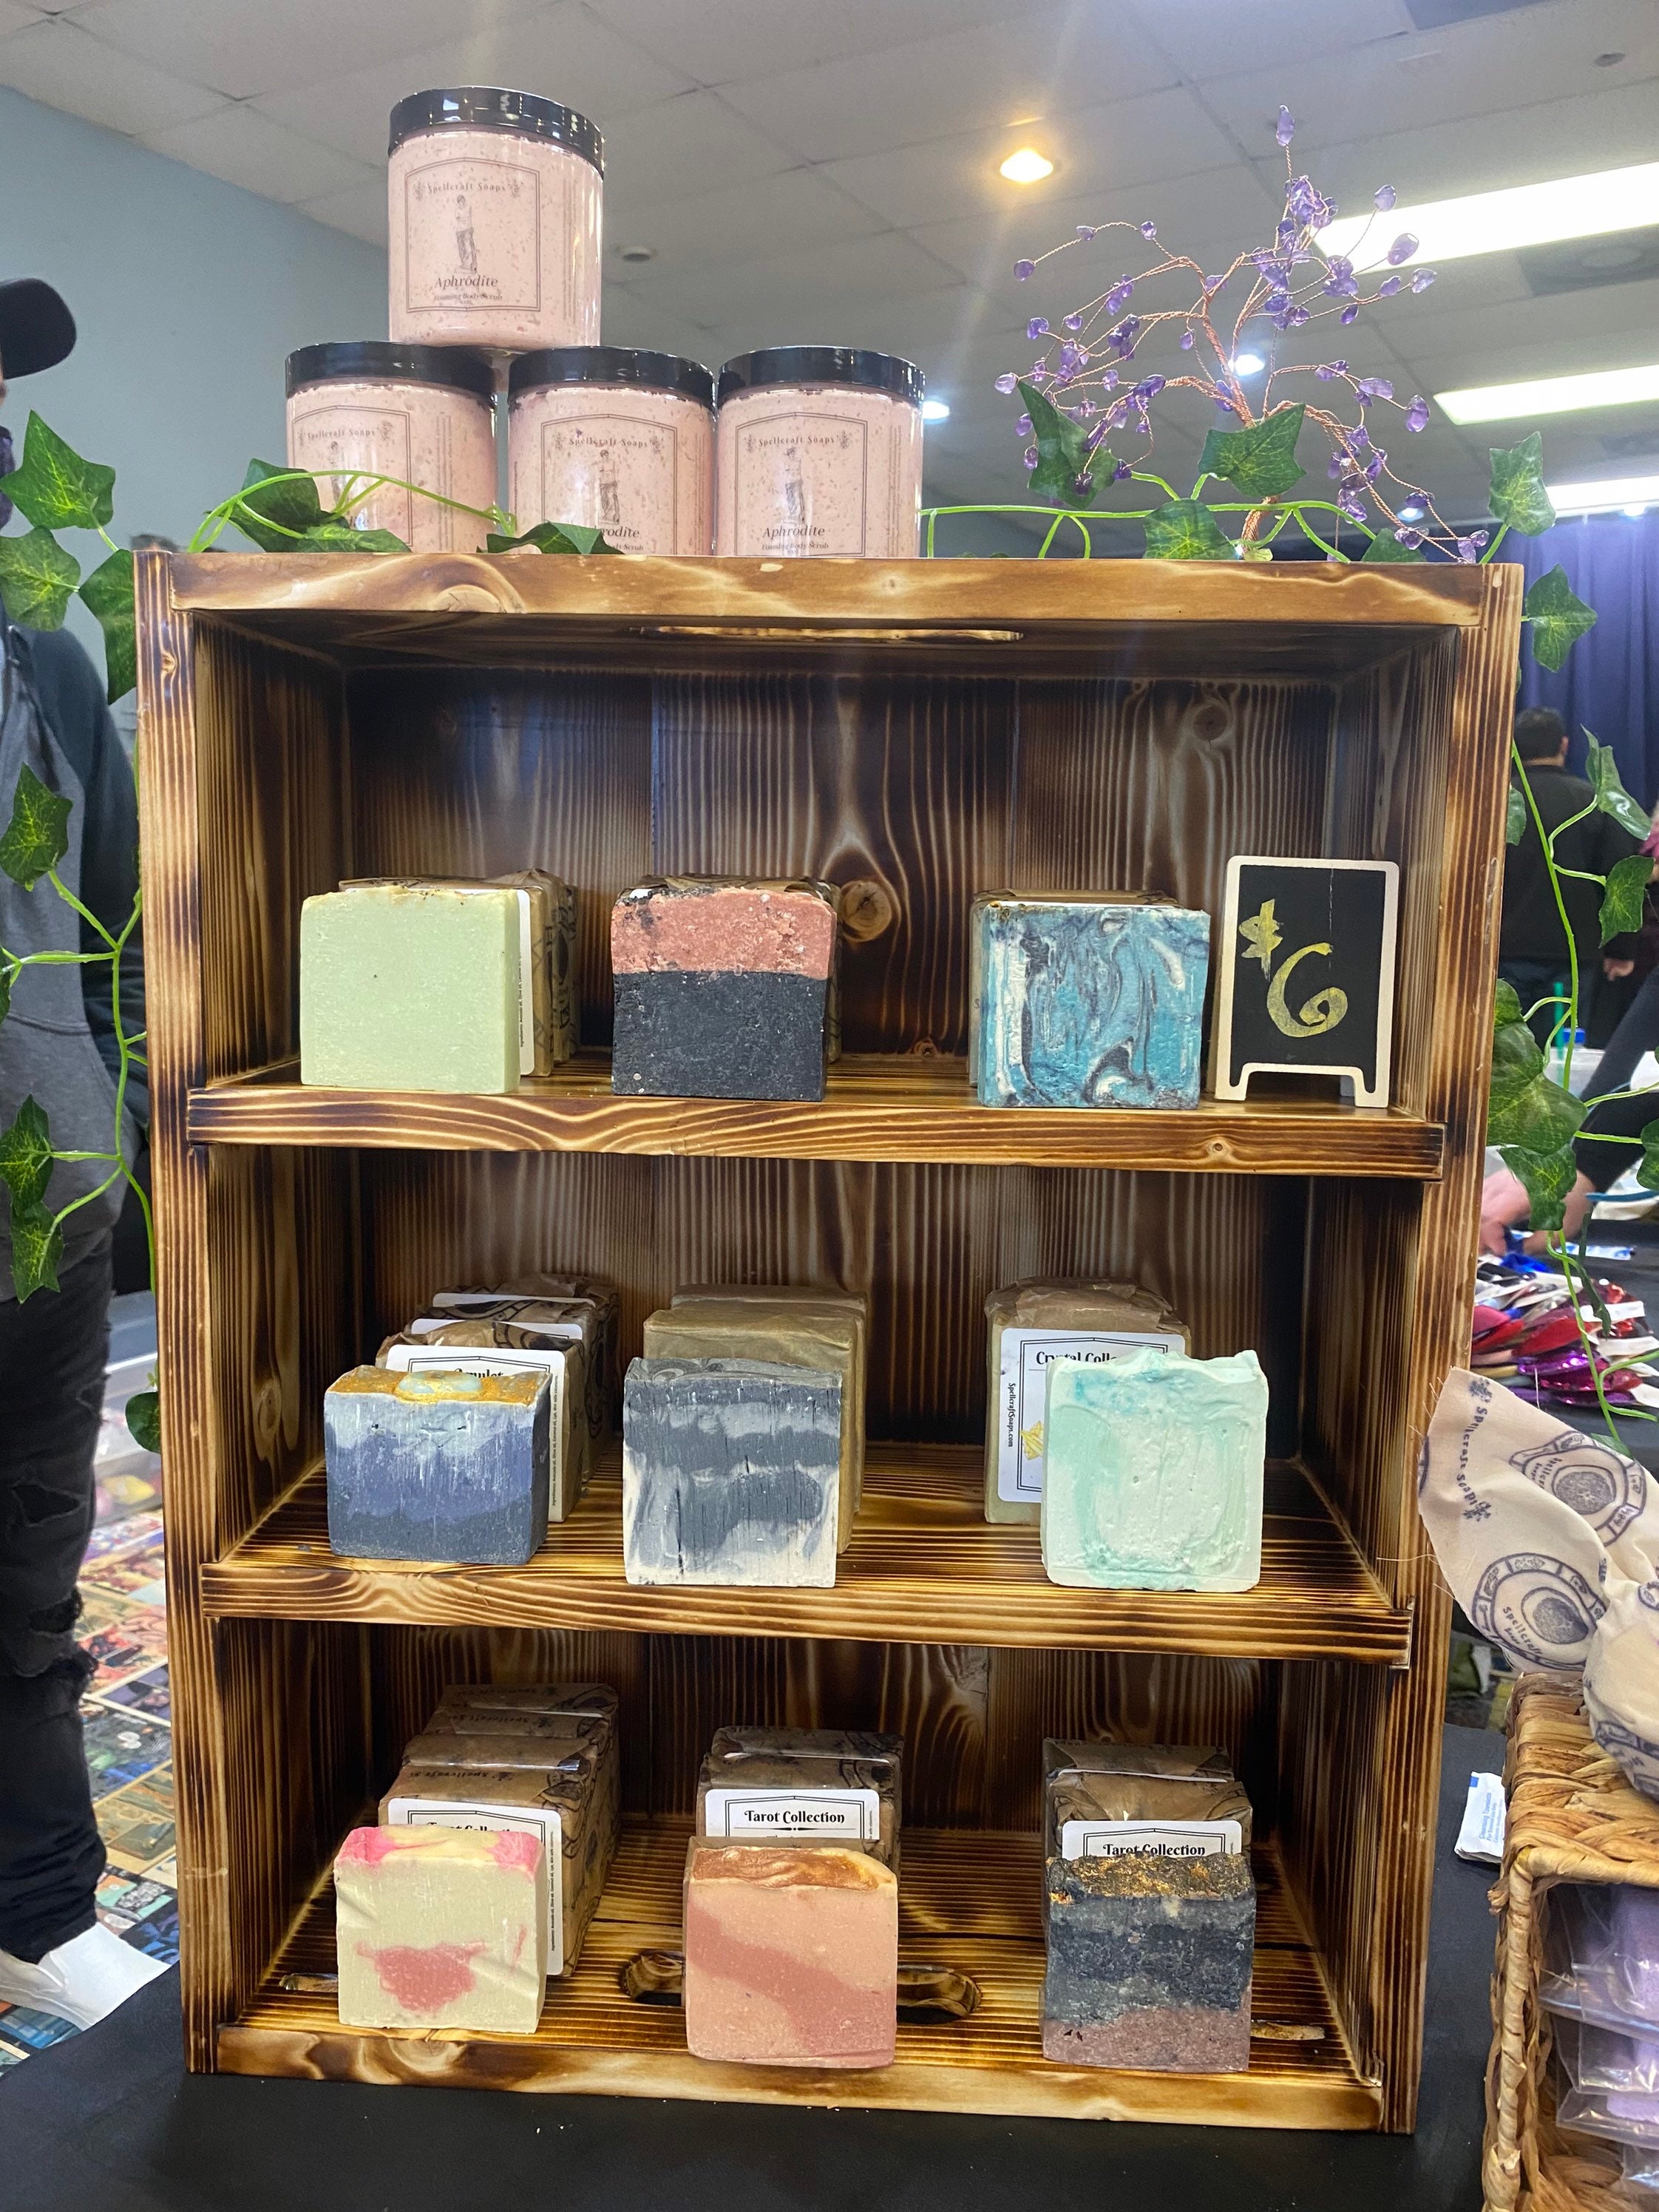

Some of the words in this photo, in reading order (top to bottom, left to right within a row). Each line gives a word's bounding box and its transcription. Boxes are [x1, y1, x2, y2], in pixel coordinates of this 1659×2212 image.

[478, 182, 506, 192] Soaps
[435, 275, 498, 290] Aphrodite
[349, 429, 375, 438] Soaps
[622, 438, 648, 448] Soaps
[759, 436, 802, 447] Spellcraft
[807, 435, 835, 444] Soaps
[603, 526, 639, 537] rodite
[762, 523, 825, 540] Aphrodite
[1007, 1382, 1017, 1448] SpellcraftSoaps.com
[744, 1810, 780, 1822] Tarot
[783, 1811, 845, 1824] Collection
[1102, 1844, 1139, 1855] Tarot
[1142, 1843, 1206, 1856] Collection
